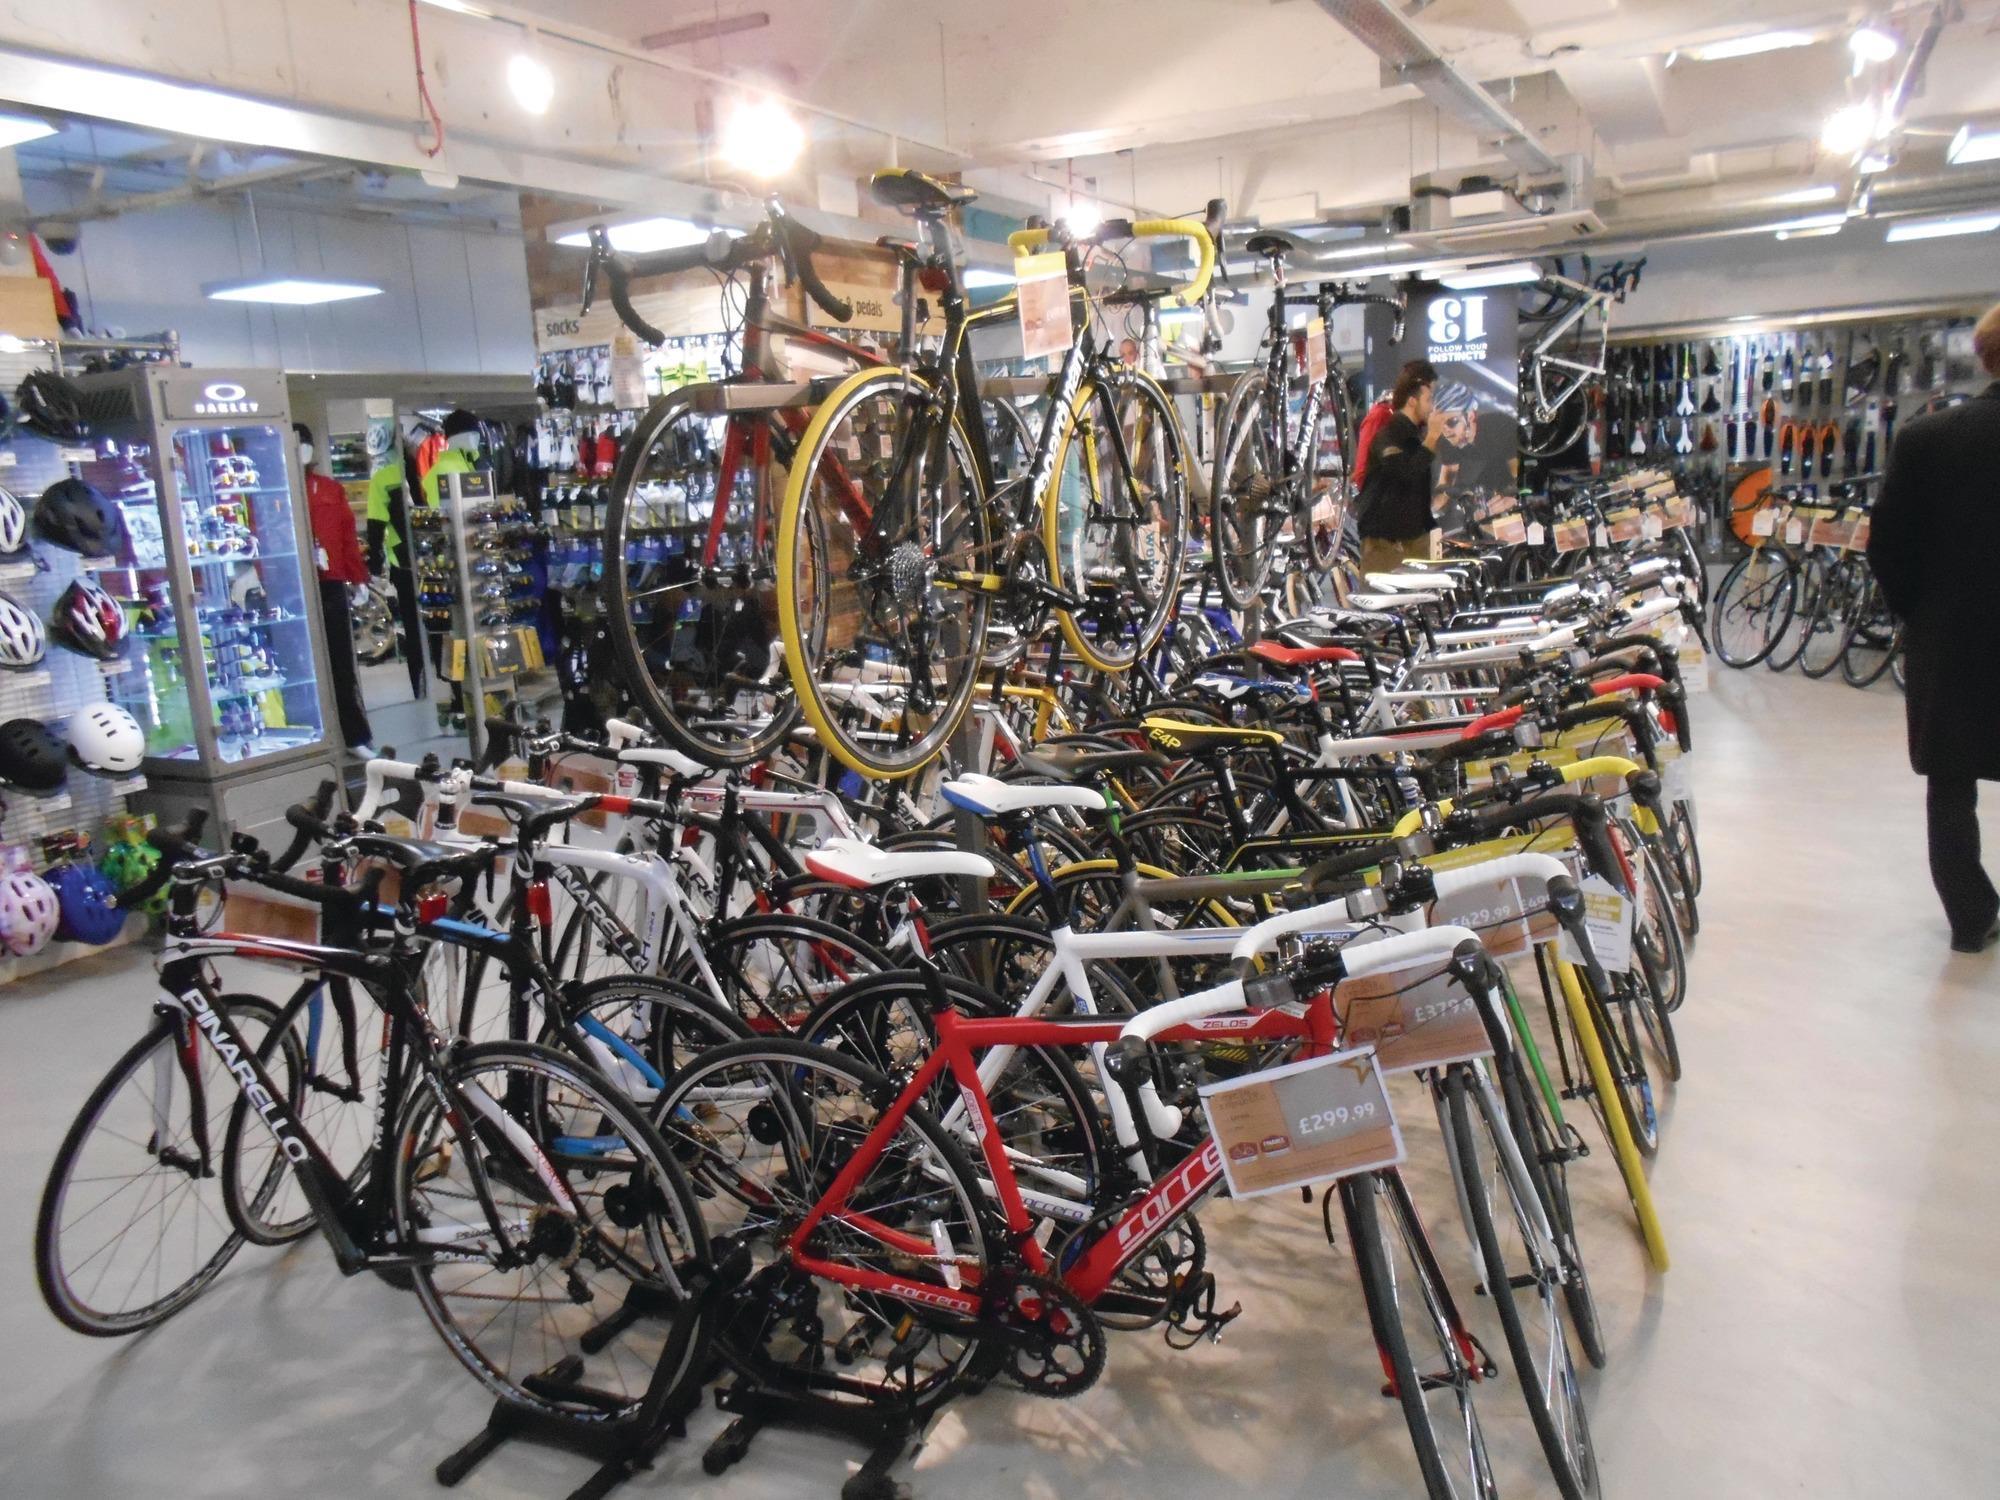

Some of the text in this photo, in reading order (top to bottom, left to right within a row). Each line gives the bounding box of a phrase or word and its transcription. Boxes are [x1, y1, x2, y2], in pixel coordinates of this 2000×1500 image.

[856, 298, 883, 319] pedals
[546, 318, 580, 337] socks
[1428, 343, 1488, 353] FOLLOW YOUR
[1429, 350, 1487, 363] INSTINCTS
[194, 402, 259, 414] OAKLEY
[1149, 727, 1182, 748] E4P
[1414, 996, 1475, 1023] £379.9
[1202, 1019, 1249, 1029] ZELOS
[180, 988, 309, 1163] PINARELLO
[1299, 1101, 1376, 1135] £299.99
[891, 1283, 972, 1309] carrera
